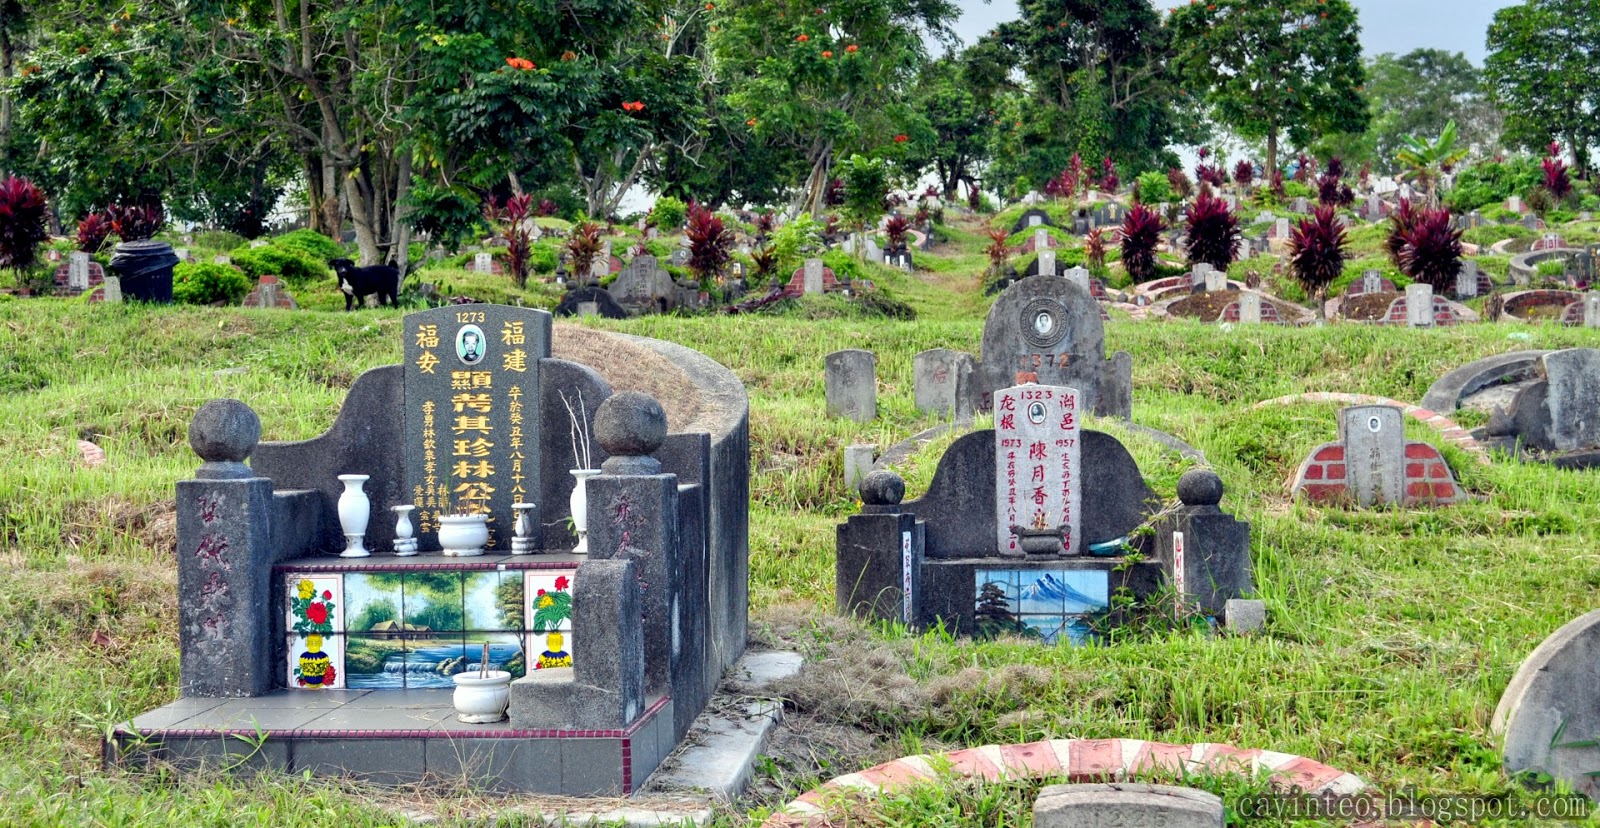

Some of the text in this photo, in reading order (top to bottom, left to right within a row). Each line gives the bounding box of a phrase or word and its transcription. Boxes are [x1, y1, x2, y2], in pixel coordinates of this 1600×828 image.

[456, 311, 486, 323] 1273
[415, 323, 440, 375] 福安
[501, 320, 528, 373] 福建
[1022, 353, 1070, 368] 1372
[1020, 390, 1053, 401] 1323
[1001, 438, 1022, 448] 1973
[1055, 438, 1075, 448] 1957
